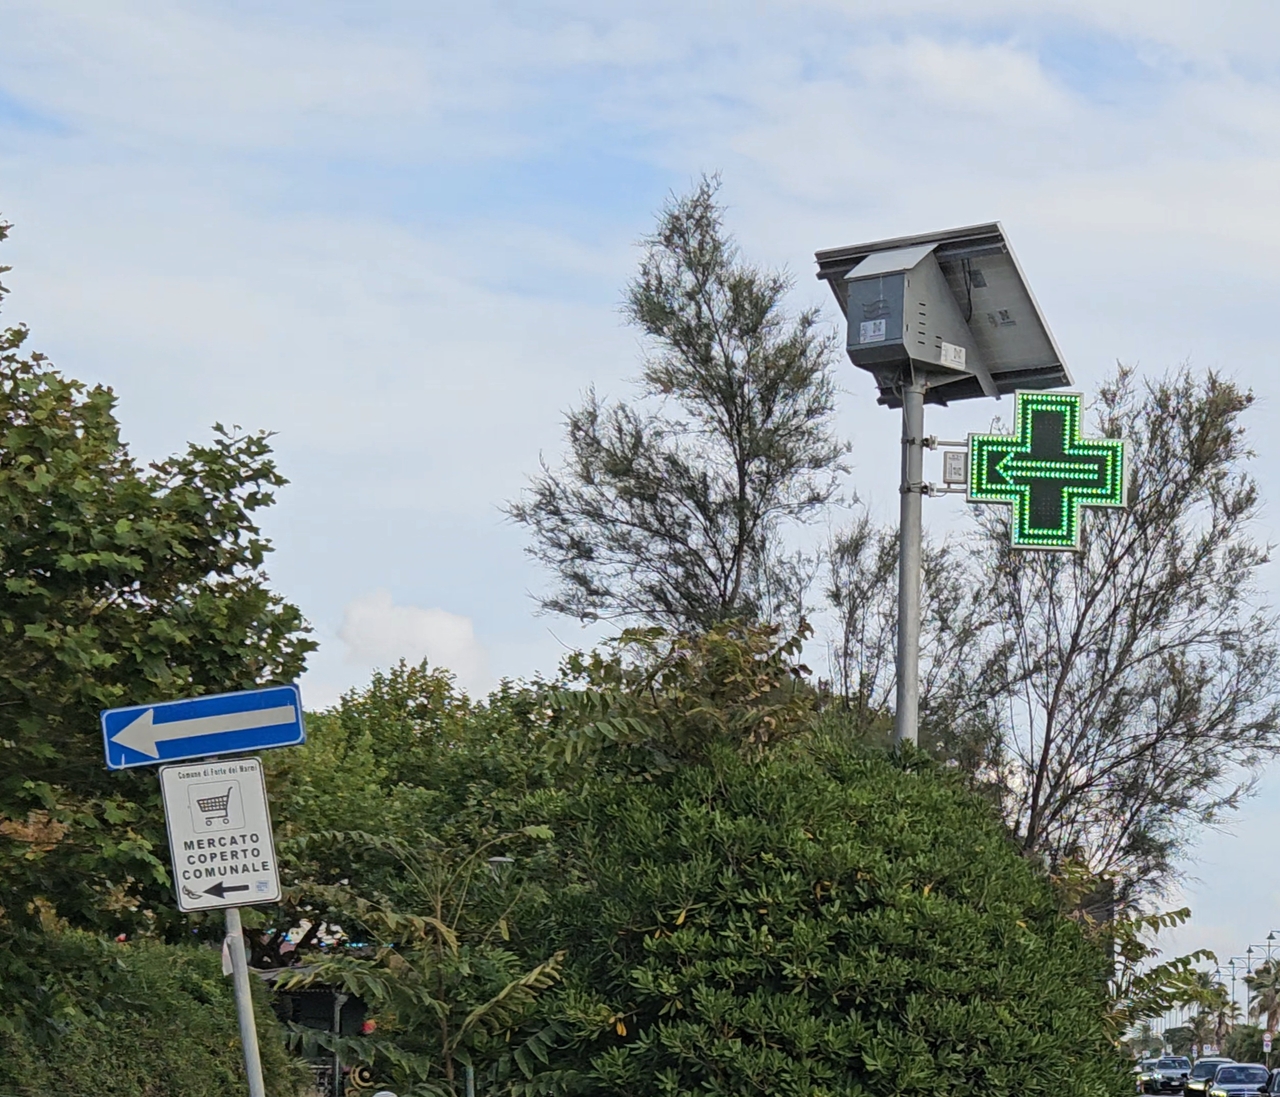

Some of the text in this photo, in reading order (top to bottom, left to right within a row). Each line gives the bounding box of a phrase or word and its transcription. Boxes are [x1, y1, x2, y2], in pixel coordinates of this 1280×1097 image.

[183, 833, 259, 851] MERCATO
[187, 847, 260, 865] COPERTO
[182, 861, 270, 880] COMUNALE
